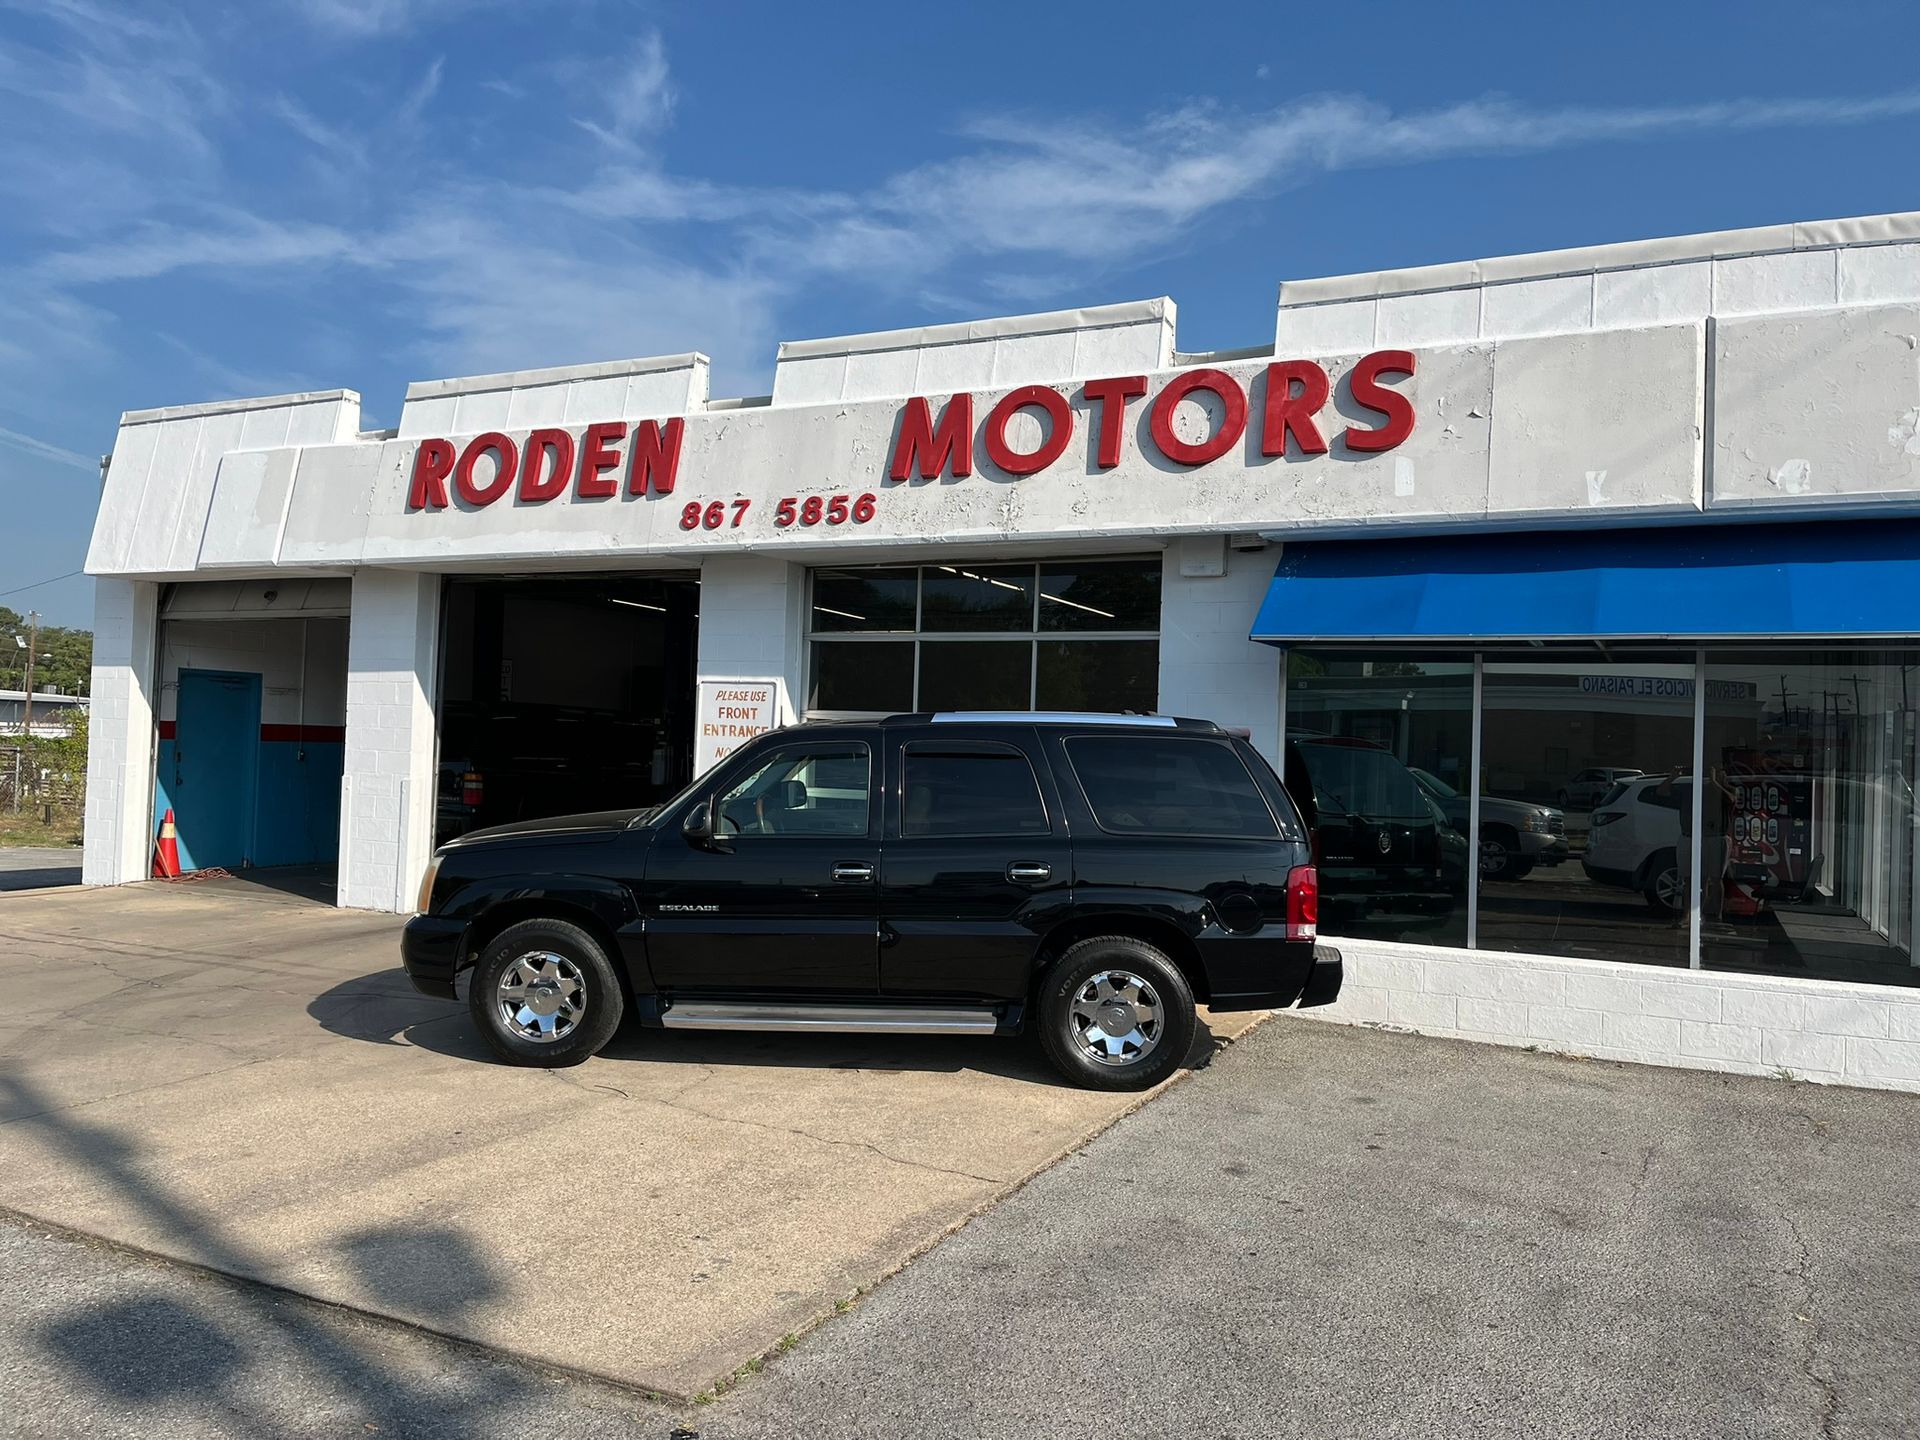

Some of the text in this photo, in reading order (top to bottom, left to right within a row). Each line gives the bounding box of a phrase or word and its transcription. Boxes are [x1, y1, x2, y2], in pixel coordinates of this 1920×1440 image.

[890, 350, 1416, 483] MOTORS
[409, 416, 686, 510] RODEN
[680, 493, 877, 531] 867 5856
[715, 690, 767, 702] PLEASE USE
[718, 706, 758, 720] FRONT
[659, 904, 720, 912] ESCALADE
